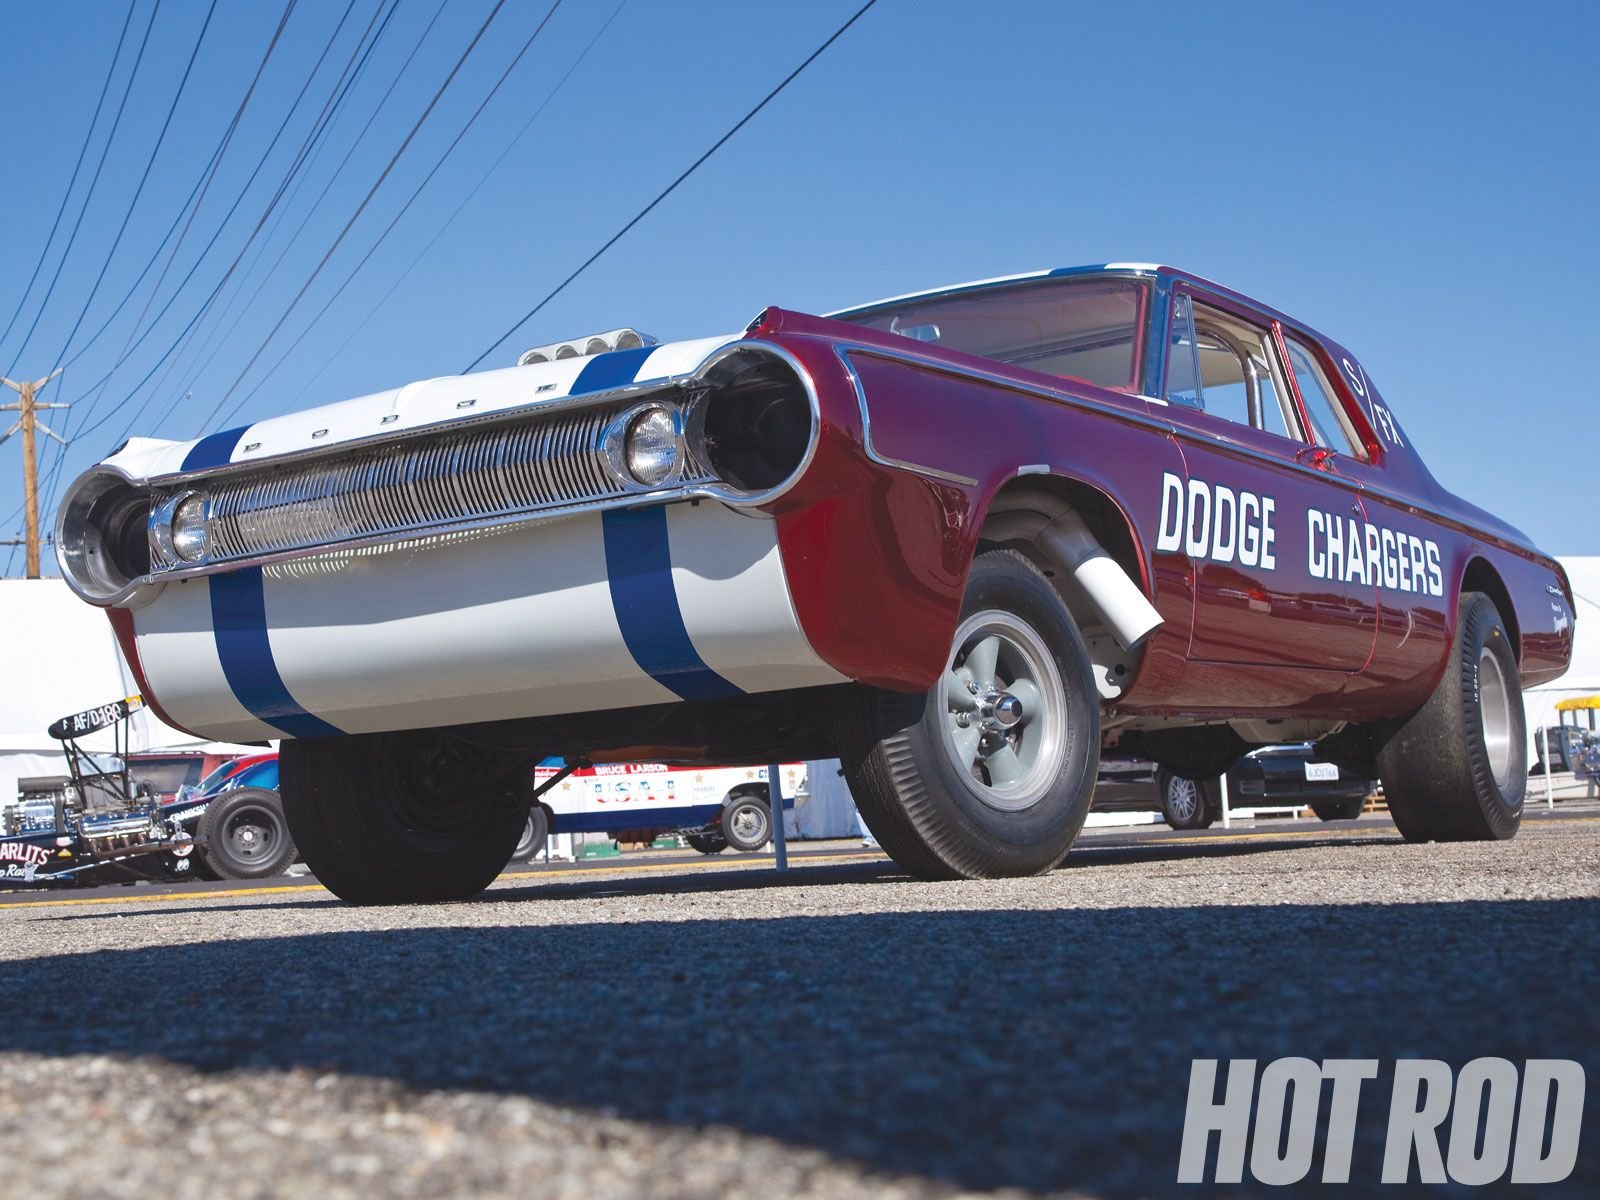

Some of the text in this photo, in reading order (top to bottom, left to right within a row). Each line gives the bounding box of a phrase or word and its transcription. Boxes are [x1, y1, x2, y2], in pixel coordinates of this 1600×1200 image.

[1156, 472, 1444, 597] DODGE CHARGERS
[595, 763, 668, 776] BRUCE LARSON
